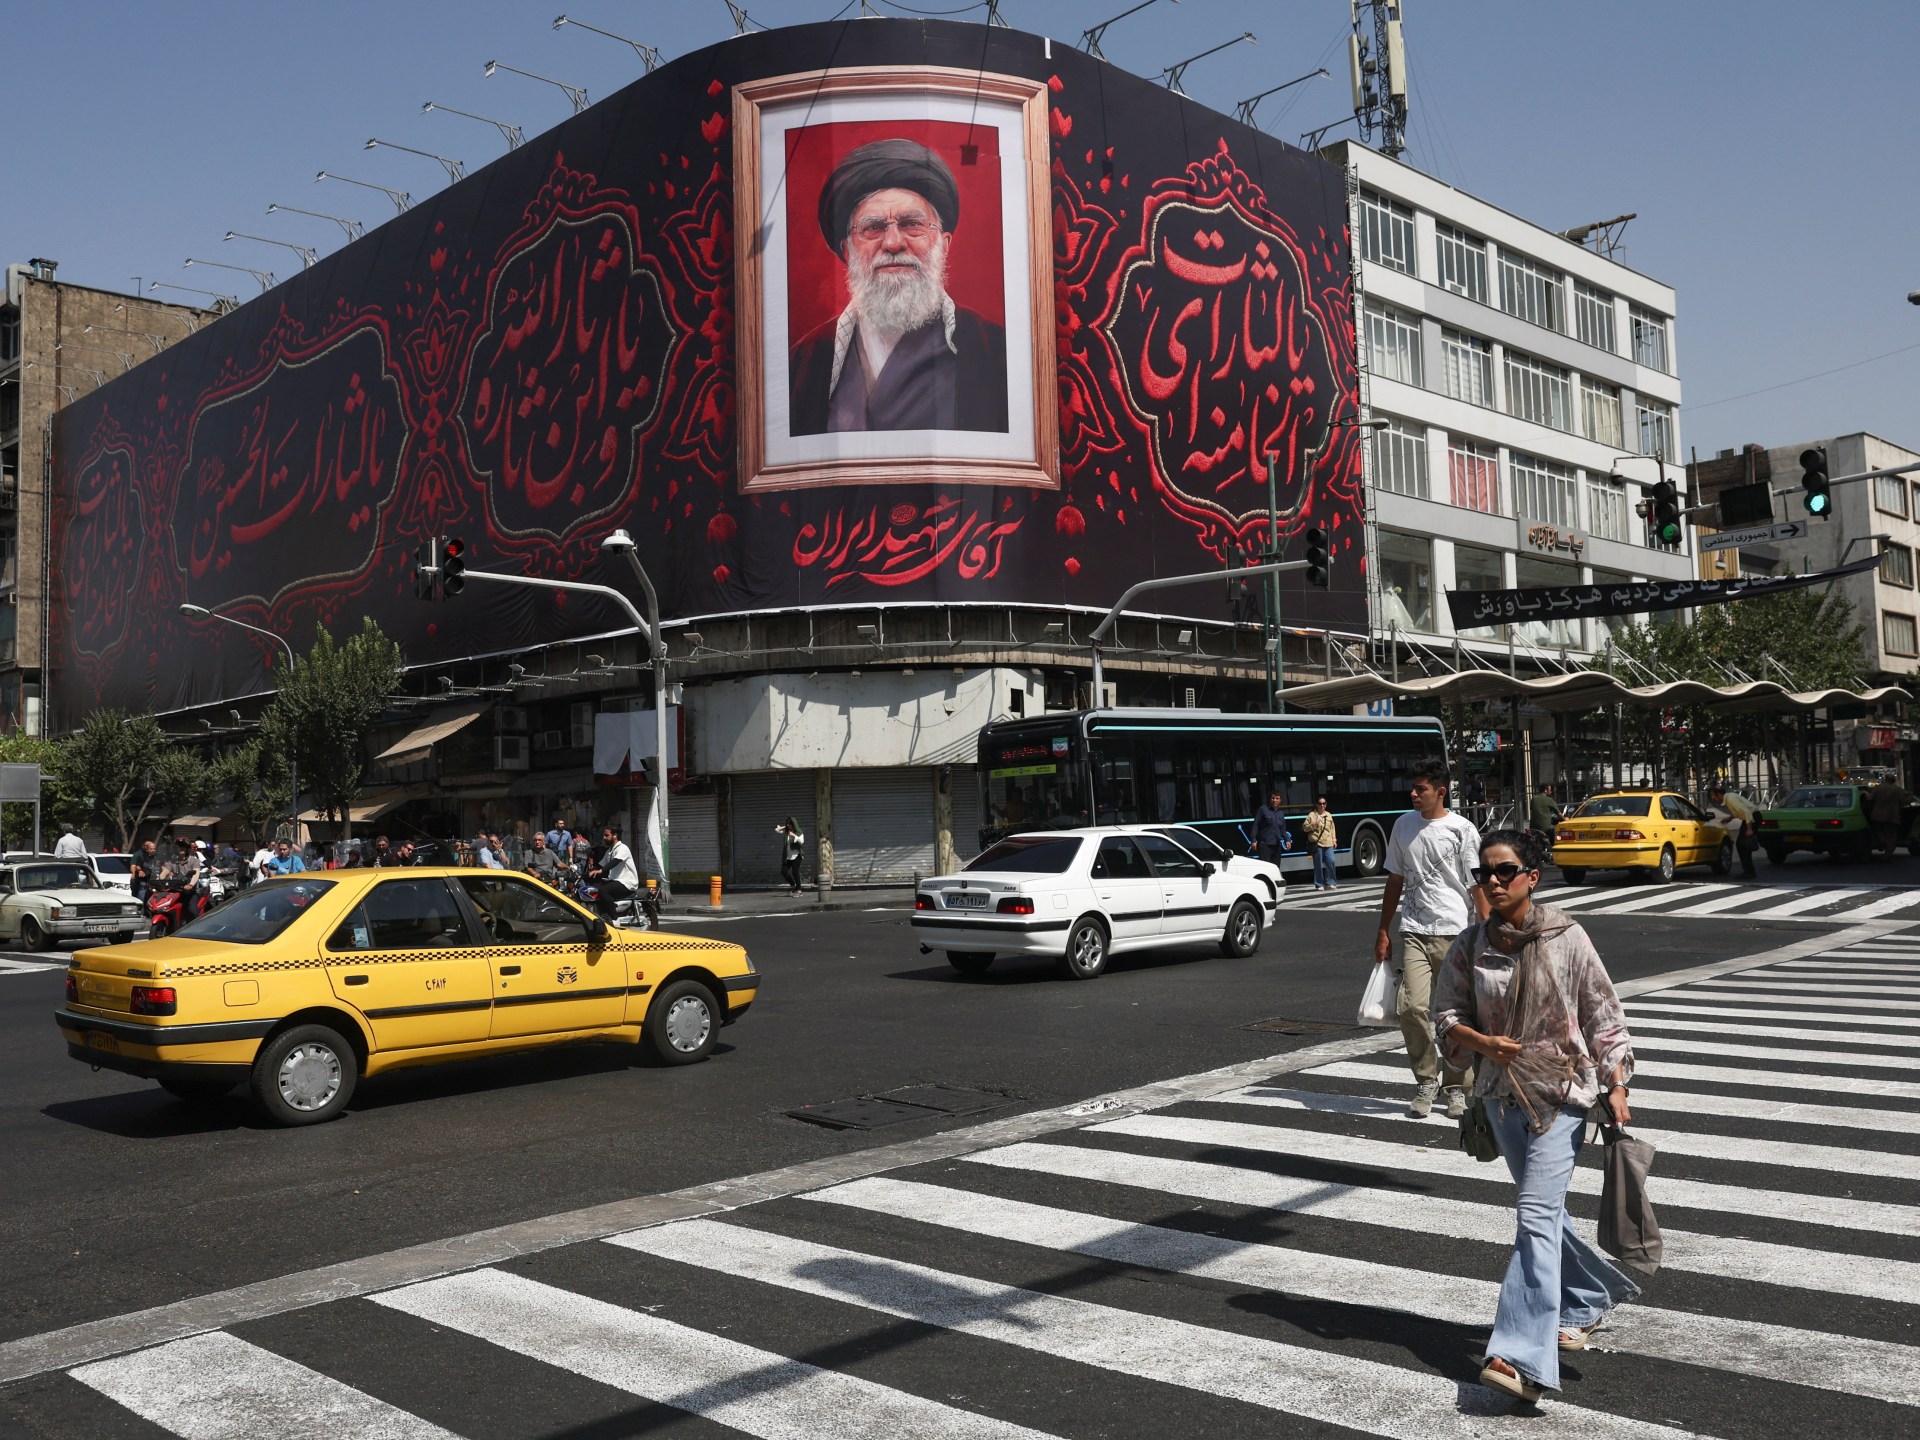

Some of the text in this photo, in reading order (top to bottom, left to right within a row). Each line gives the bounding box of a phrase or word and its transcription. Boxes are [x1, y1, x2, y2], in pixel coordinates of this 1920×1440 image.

[793, 504, 877, 589] ایران
[858, 499, 967, 572] شهید
[1704, 530, 1769, 549] جمهوری اسلامی
